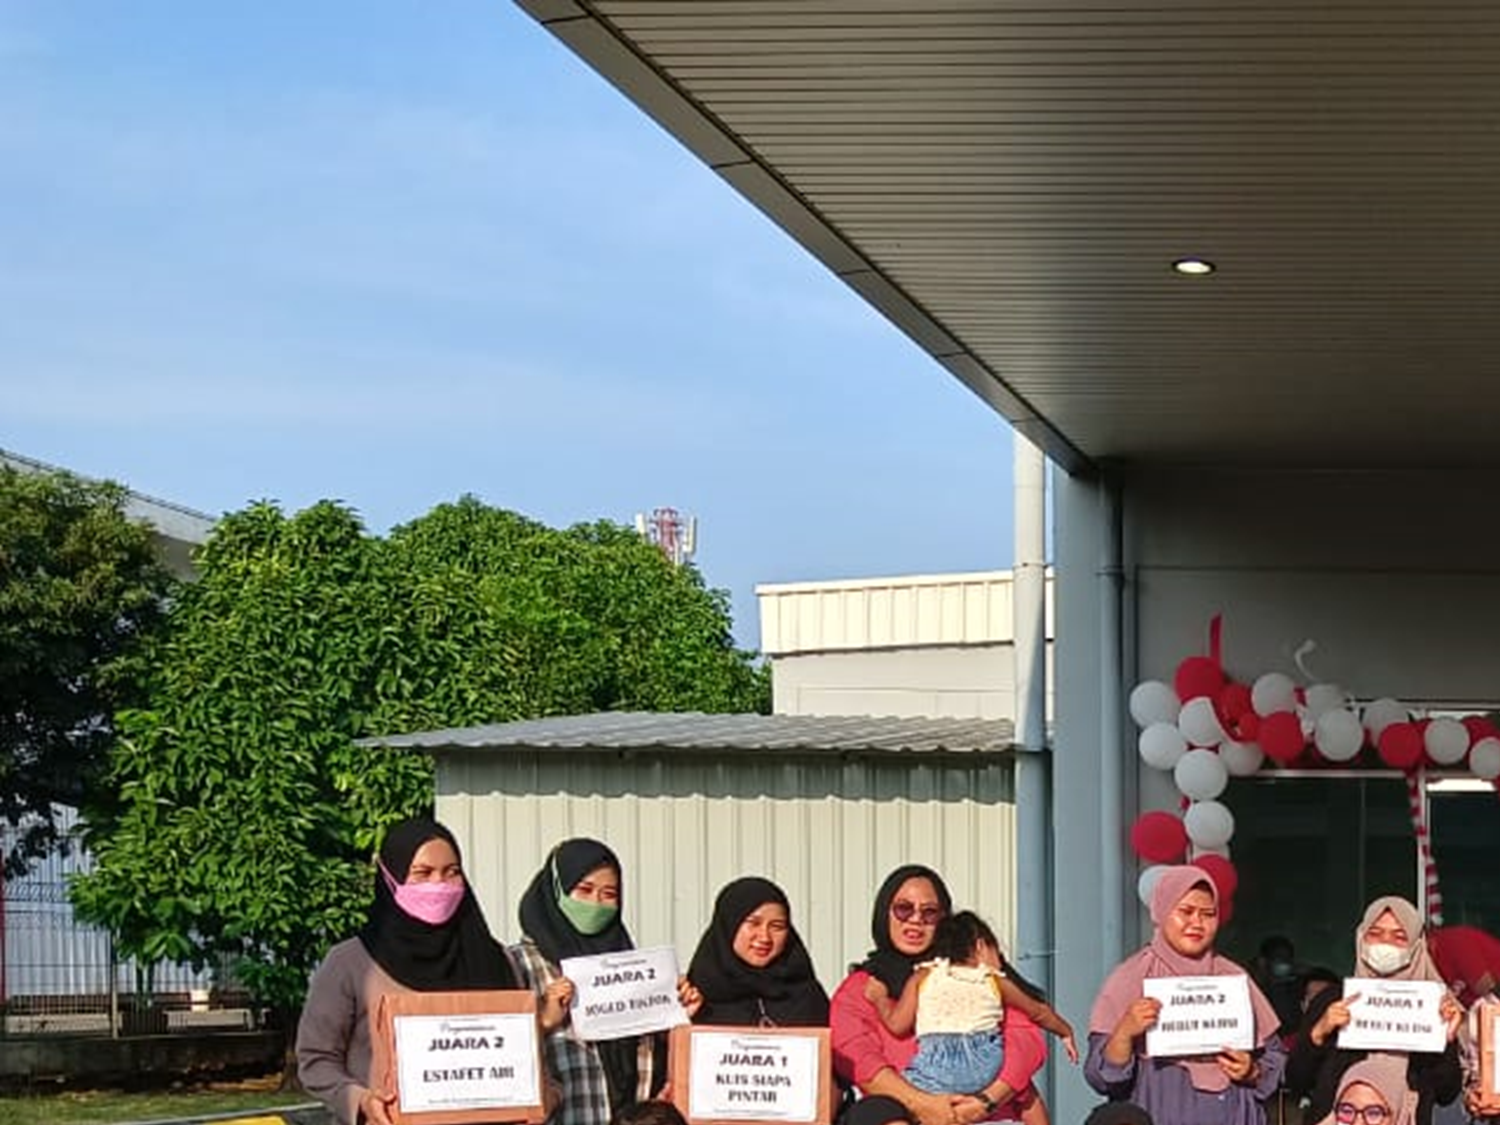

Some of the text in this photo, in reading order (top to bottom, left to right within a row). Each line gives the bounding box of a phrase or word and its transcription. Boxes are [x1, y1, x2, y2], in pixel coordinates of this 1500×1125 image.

[592, 968, 656, 988] JUARA 2
[1170, 993, 1226, 1006] JUARA 2
[1365, 996, 1412, 1009] JUARA
[428, 1036, 505, 1052] JUARA 2
[719, 1053, 788, 1067] JUARA 1
[423, 1066, 515, 1082] ESTAFET AIR
[716, 1073, 791, 1087] KUIS SIAPA
[728, 1090, 778, 1103] PINTAR
